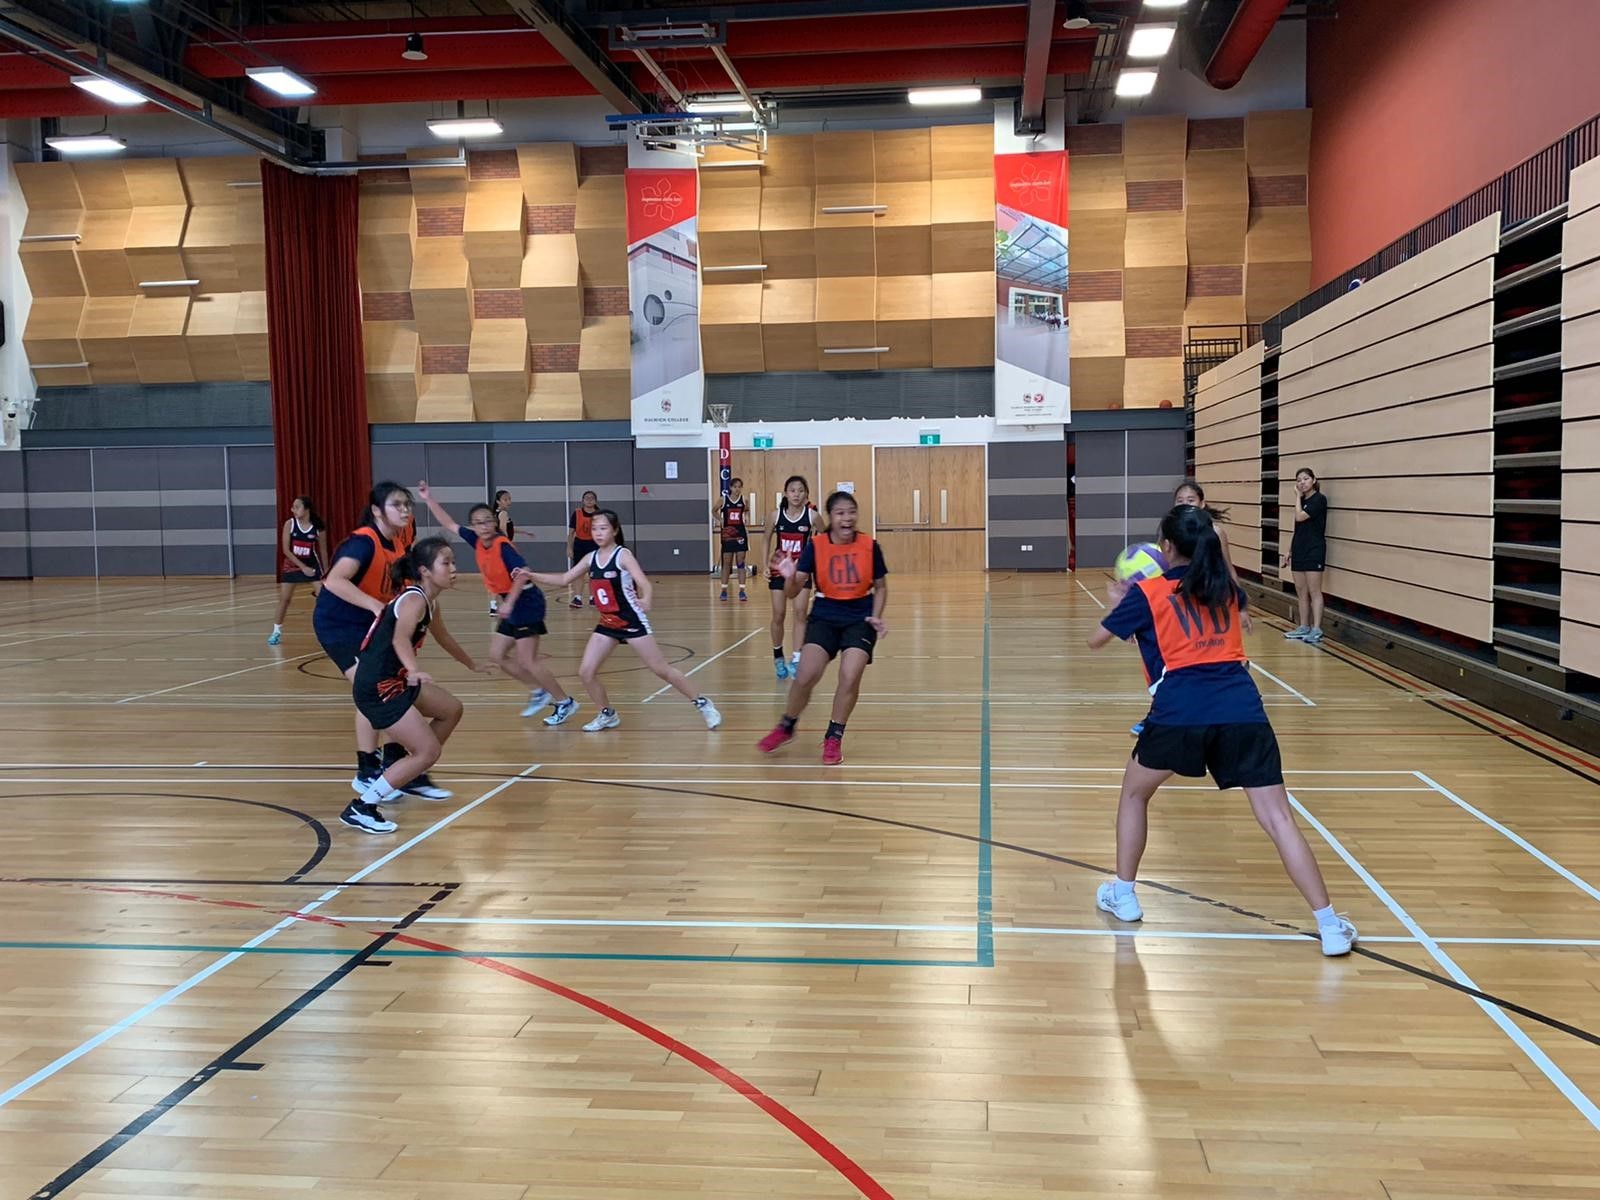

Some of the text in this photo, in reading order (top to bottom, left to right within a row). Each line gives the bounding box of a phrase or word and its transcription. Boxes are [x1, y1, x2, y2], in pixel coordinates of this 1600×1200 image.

[781, 538, 801, 552] WA
[828, 554, 862, 585] GK
[596, 588, 609, 605] C
[1168, 594, 1231, 640] WD
